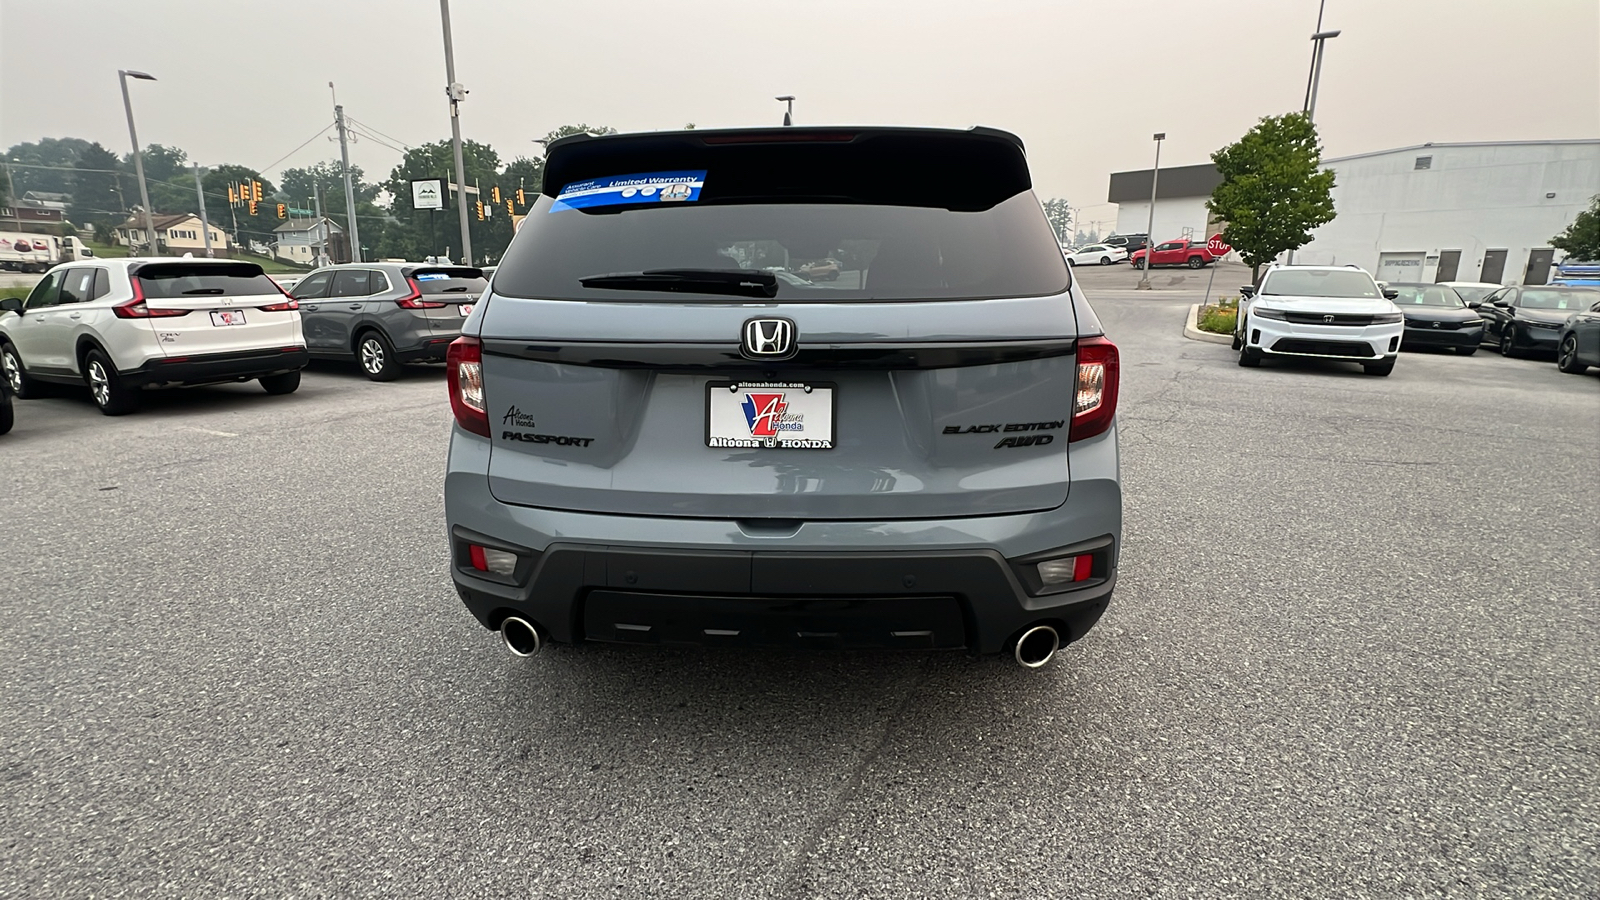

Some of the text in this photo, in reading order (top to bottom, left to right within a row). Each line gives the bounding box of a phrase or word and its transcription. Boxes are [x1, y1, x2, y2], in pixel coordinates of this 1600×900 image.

[609, 176, 697, 187] Limited Warranty
[515, 420, 535, 428] Honda
[772, 421, 803, 431] Honda
[942, 420, 1065, 434] BLACK EDITION
[502, 430, 595, 448] PASSPORT
[709, 437, 760, 448] Altoona
[781, 439, 832, 449] HONDA
[993, 434, 1054, 449] AWD
